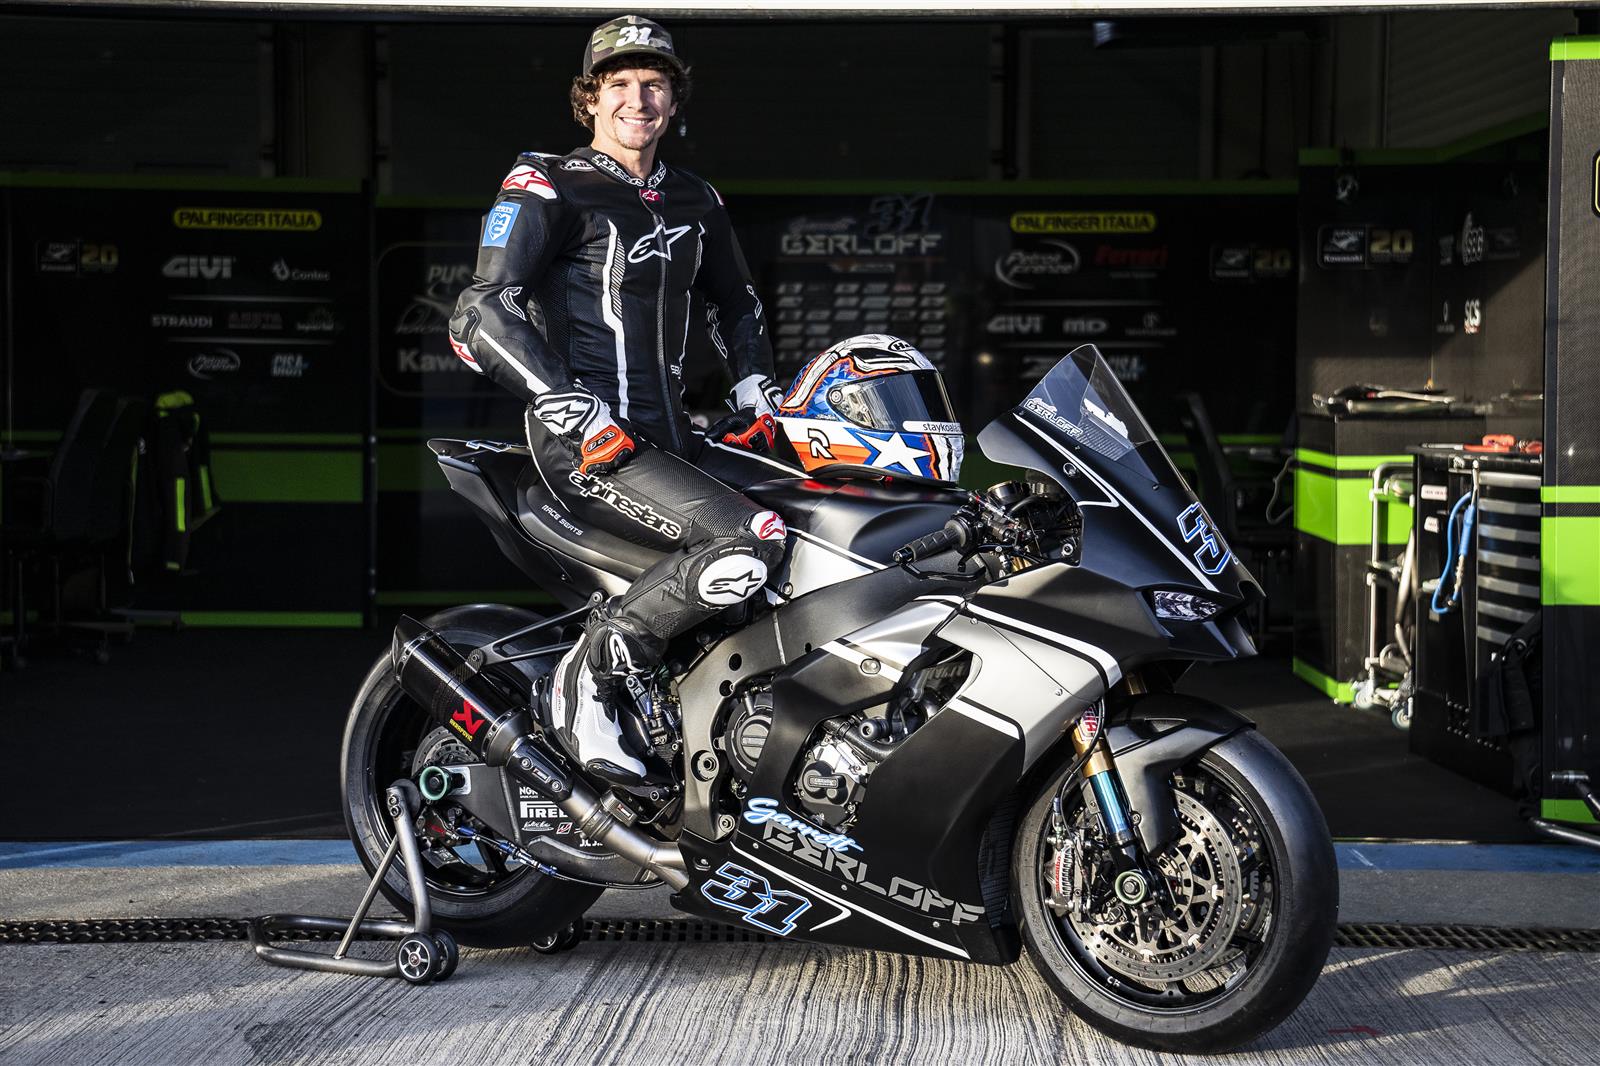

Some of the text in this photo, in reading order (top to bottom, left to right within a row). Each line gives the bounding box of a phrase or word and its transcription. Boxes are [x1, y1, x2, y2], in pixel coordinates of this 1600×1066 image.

[615, 25, 652, 47] 31
[179, 211, 317, 229] PALFINGER ITALIA
[1016, 215, 1150, 230] PALFINGER ITALIA
[780, 233, 942, 255] GERLOFF
[161, 255, 233, 279] GIVI
[151, 314, 214, 329] STRAUDI
[985, 314, 1046, 335] GIVI
[1024, 399, 1083, 438] GERLOFF
[568, 469, 682, 540] alpinestars
[541, 504, 584, 536] RACE SEATS
[520, 800, 569, 818] PIREL
[743, 797, 864, 853] Garrett
[762, 819, 985, 926] GERLOFF
[700, 860, 812, 937] 31
